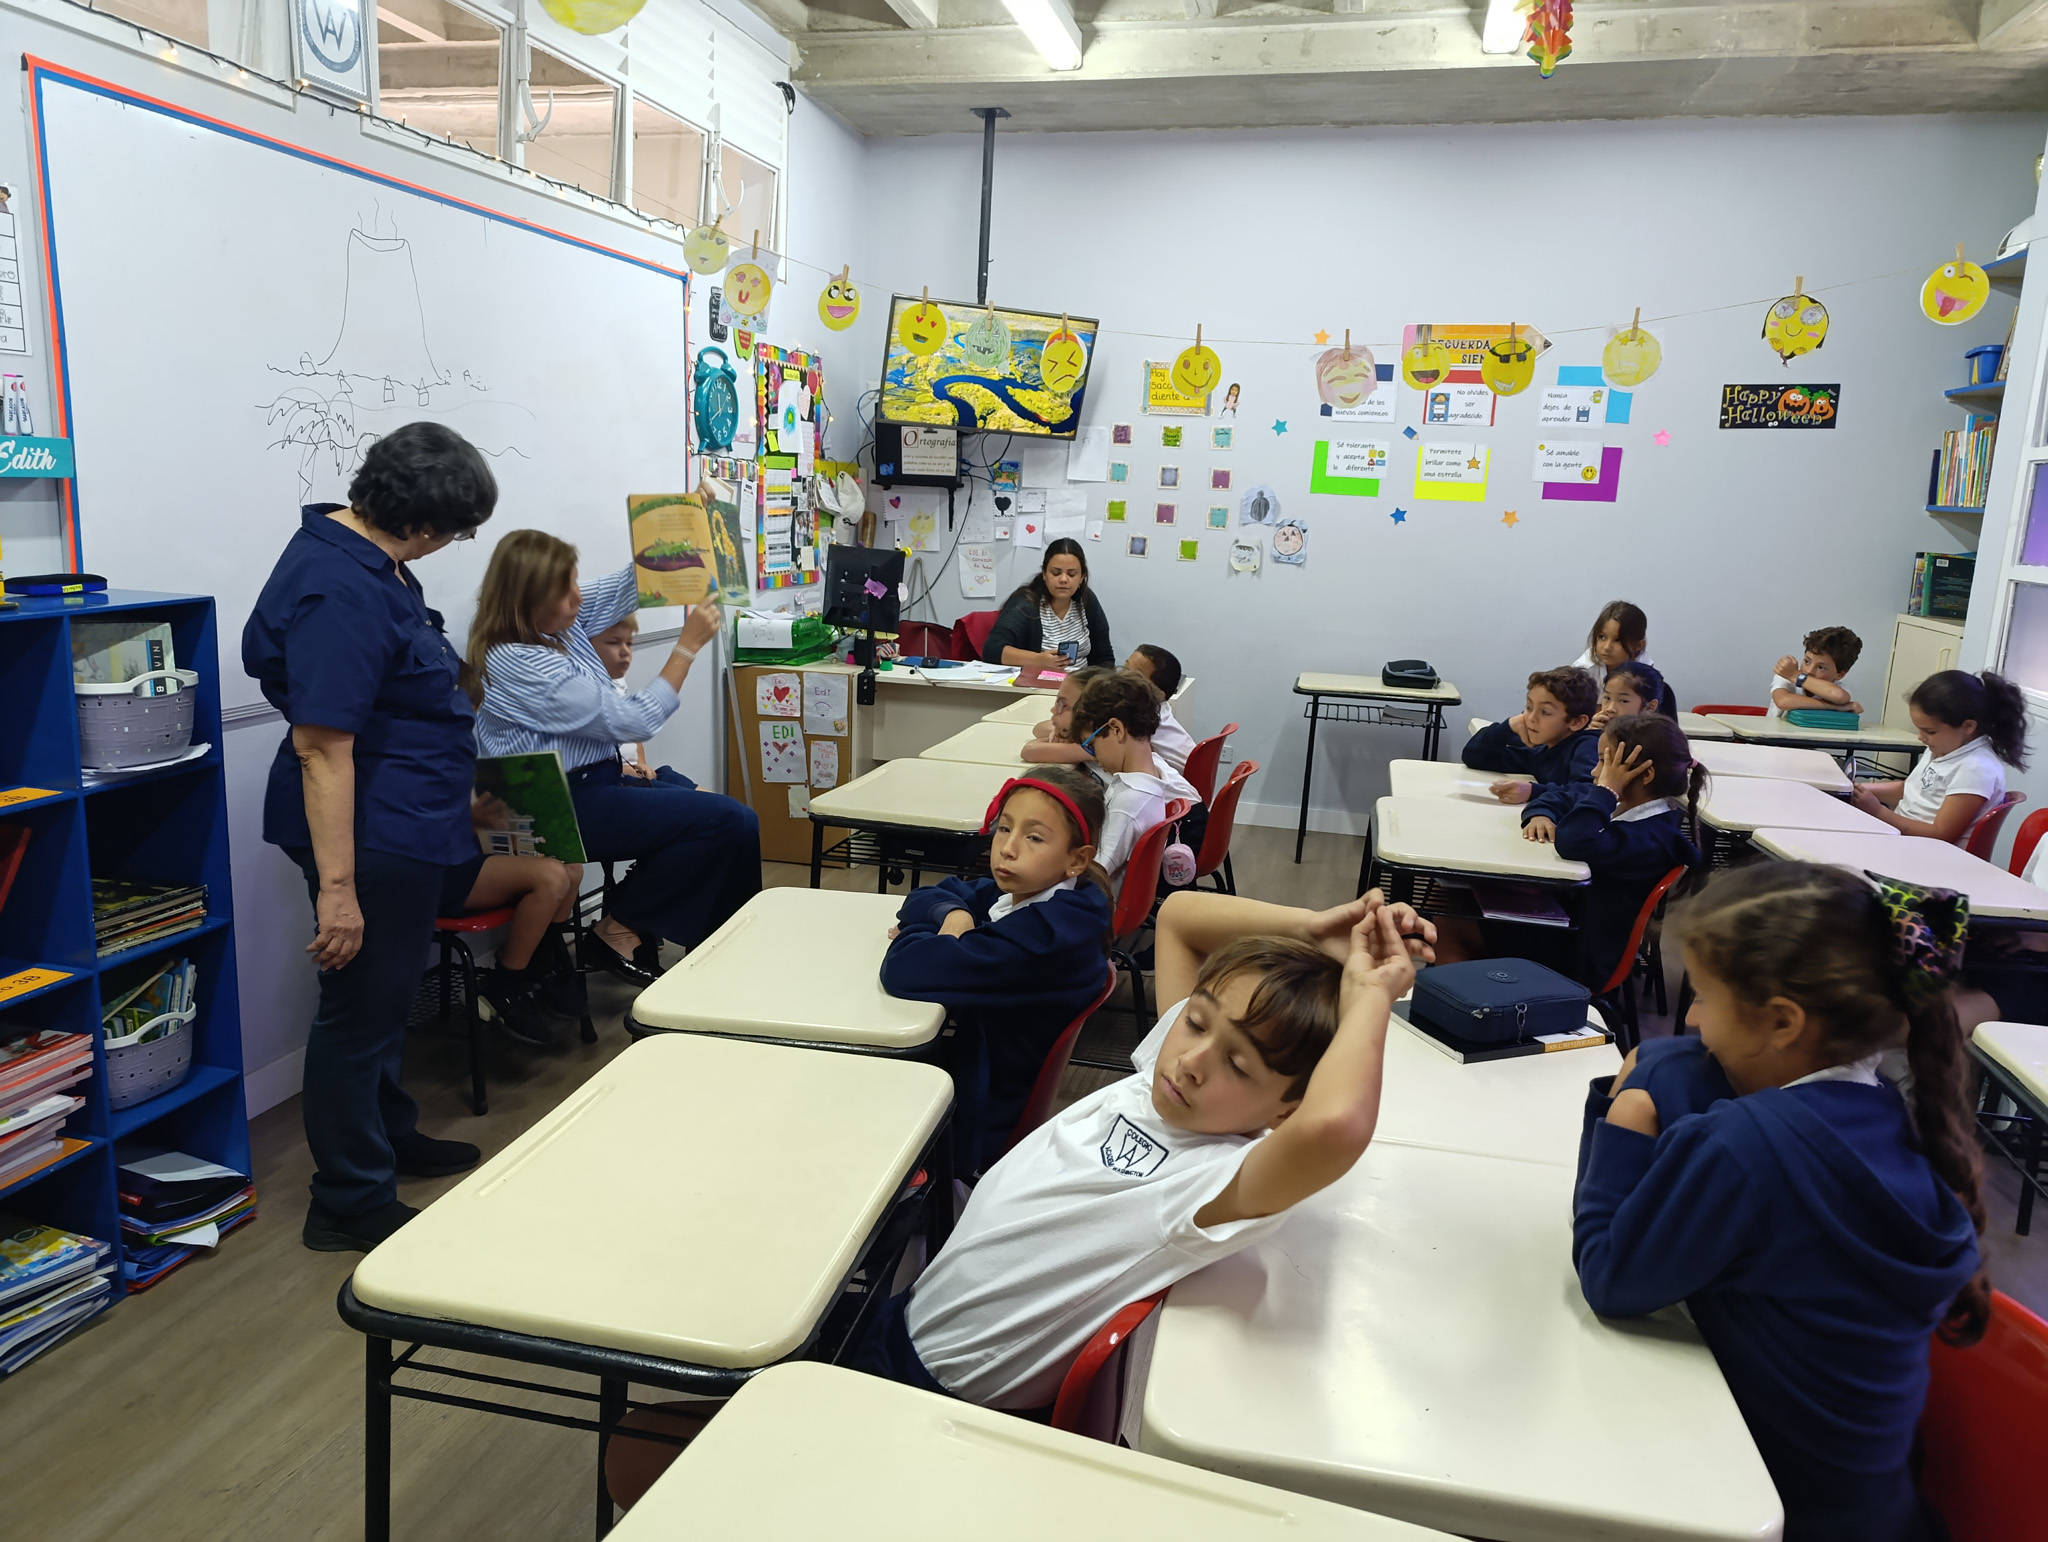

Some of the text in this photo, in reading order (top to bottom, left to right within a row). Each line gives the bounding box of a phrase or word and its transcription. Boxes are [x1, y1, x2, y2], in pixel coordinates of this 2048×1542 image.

[1430, 339, 1491, 351] CUERDA
[1151, 391, 1180, 401] diente
[1722, 385, 1782, 408] Happy
[1542, 403, 1560, 412] dejes
[1448, 412, 1483, 421] agradecido
[1541, 415, 1572, 423] aprender
[1724, 404, 1823, 427] Halloween
[0, 439, 57, 474] Edith
[1556, 449, 1580, 457] amable
[1425, 458, 1444, 466] brillar
[1562, 462, 1582, 470] gente
[1345, 464, 1375, 472] diferente
[814, 686, 832, 697] Edi
[1126, 1128, 1153, 1152] COLEGIO
